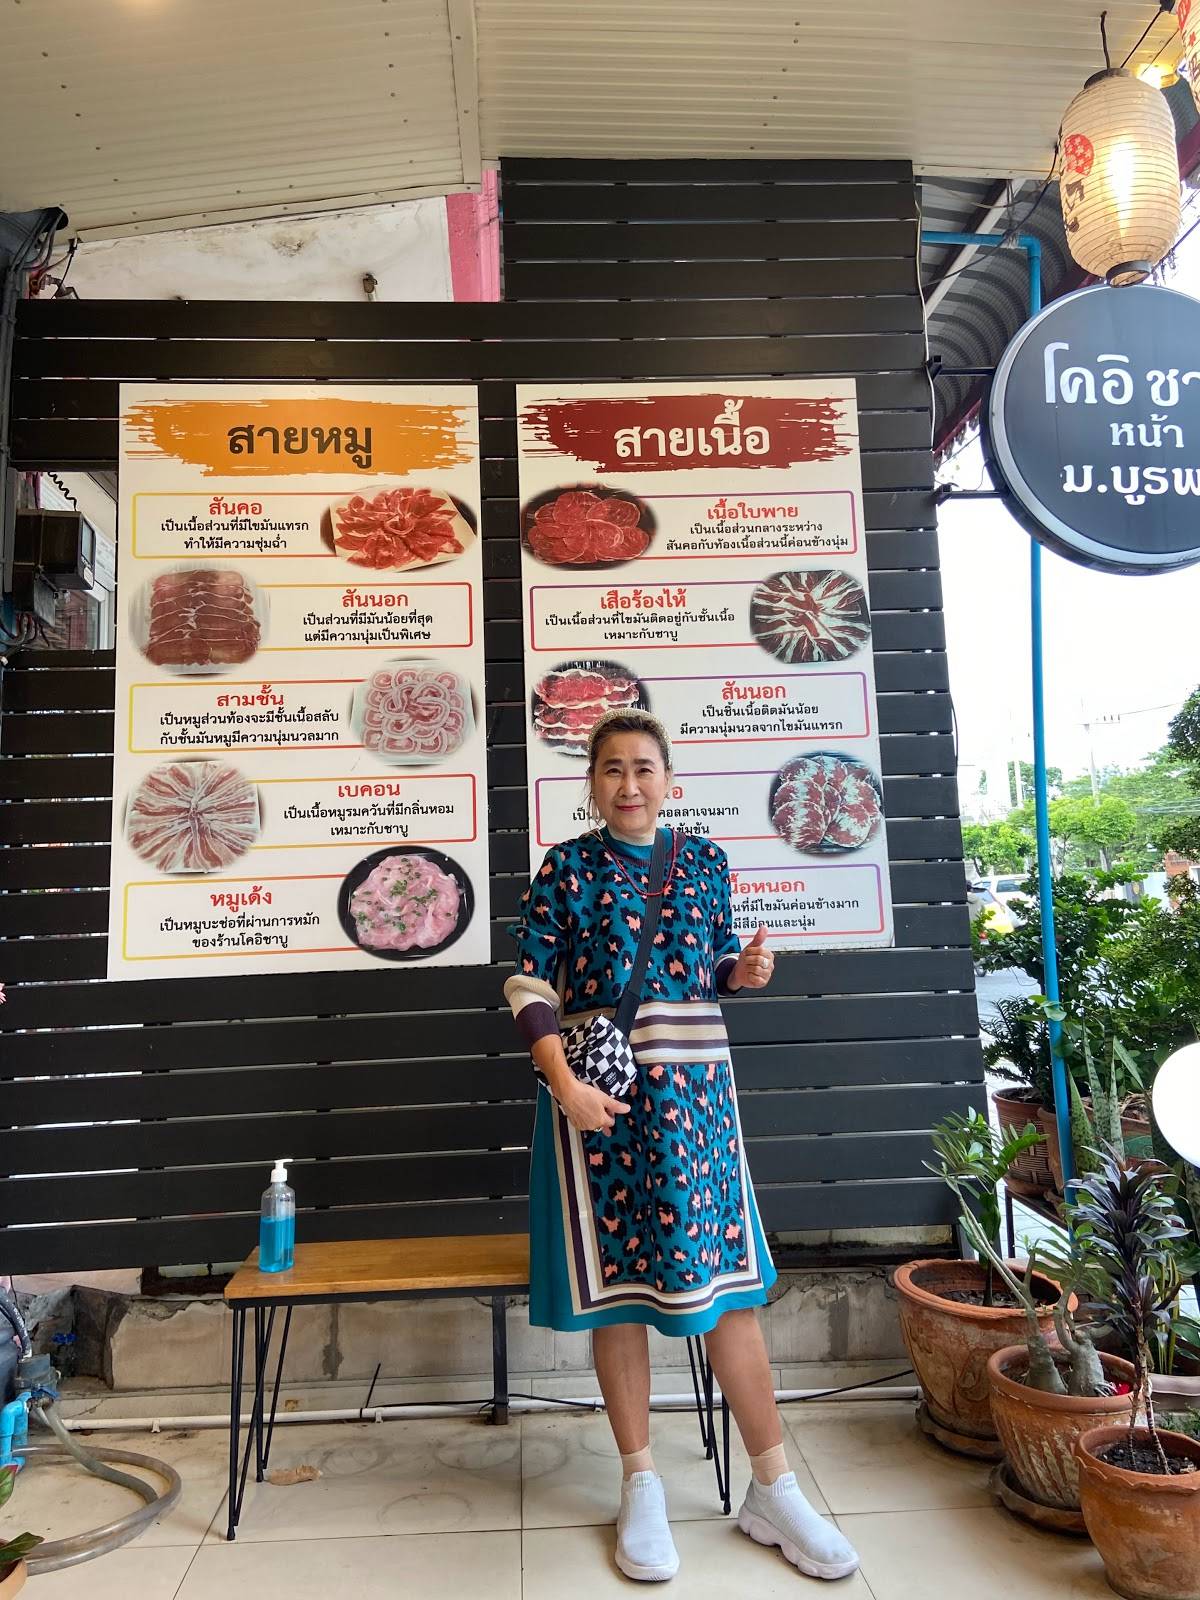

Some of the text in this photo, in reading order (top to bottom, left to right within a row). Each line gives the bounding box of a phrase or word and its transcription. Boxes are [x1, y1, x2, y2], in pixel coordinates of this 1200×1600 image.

[1044, 341, 1134, 405] โคอิ
[613, 398, 770, 458] สายเนื้อ
[1109, 413, 1185, 448] หน้า
[228, 423, 373, 470] สายหมู
[208, 496, 263, 516] สันคอ
[707, 498, 799, 520] เนื้อใบพาย
[161, 515, 309, 532] เป็นเนื้อส่วนที่มีไขมันแทรก
[690, 518, 823, 535] เป็นเนื้อส่วนกลางระหว่าง
[184, 534, 287, 552] ทำให้มีความชุ่มฉ่ำ
[666, 533, 849, 551] สันคอกับท้องเนื้อส่วนนี้ค่อนข้างนุ่ม
[342, 588, 409, 608] สันนอก
[600, 588, 687, 609] เสือร้องไห้
[303, 609, 433, 628] เป็นส่วนที่มีมันน้อยที่สุด
[545, 607, 735, 627] เป็นเนื้อส่วนที่ไขมันติดอยู่กับชั้นเนื้อ
[304, 627, 431, 644] แต่มีความนุ่มเป็นพิเศษ
[604, 628, 678, 642] เหมาะกับชาบู
[216, 684, 284, 707] สามชั้น
[721, 680, 786, 701] สันนอก
[160, 706, 339, 729] เป็นหมูส่วนท้องจะมีชั้นเนื้อสลับ
[702, 701, 819, 718] เป็นชิ้นเนื้อติดมันน้อย
[160, 728, 339, 747] กับชั้นมันหมูมีความนุ่มนวลมาก
[680, 719, 843, 738] มีความนุ่มนวลจากไขมันแทรก
[338, 783, 401, 798] เบคอน
[284, 800, 454, 821] เป็นเนื้อหมูรมควันที่มีกลิ่นหอม
[330, 821, 409, 838] เหมาะกับชาบู
[210, 885, 272, 912] หมูเด้ง
[160, 912, 320, 934] เป็นหมูบะช่อที่ผ่านการหมัก
[192, 932, 289, 949] ของร้านโคอิชาบู
